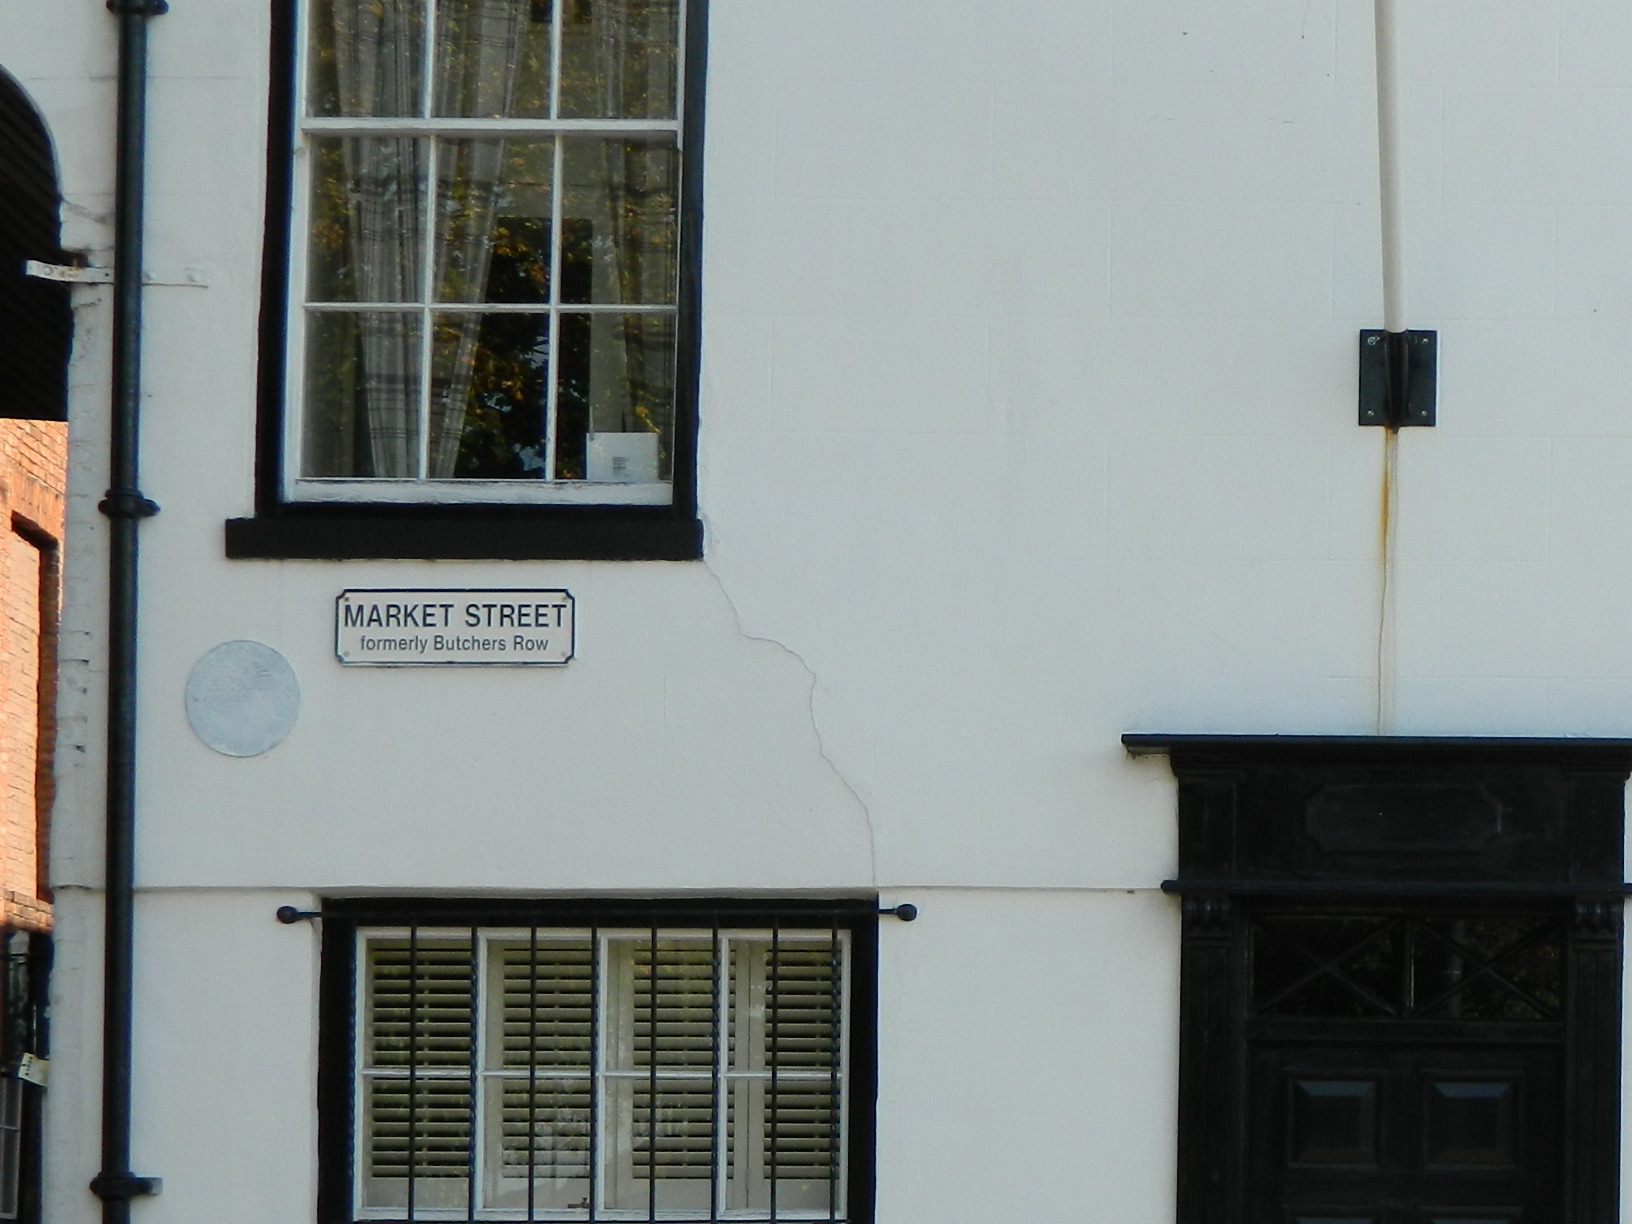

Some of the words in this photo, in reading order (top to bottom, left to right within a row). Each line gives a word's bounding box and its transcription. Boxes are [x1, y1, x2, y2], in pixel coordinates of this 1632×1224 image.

[344, 604, 454, 627] MARKET
[465, 604, 567, 627] STREET
[360, 635, 428, 654] formerly
[434, 635, 506, 651] Butchers
[513, 636, 549, 651] Row
